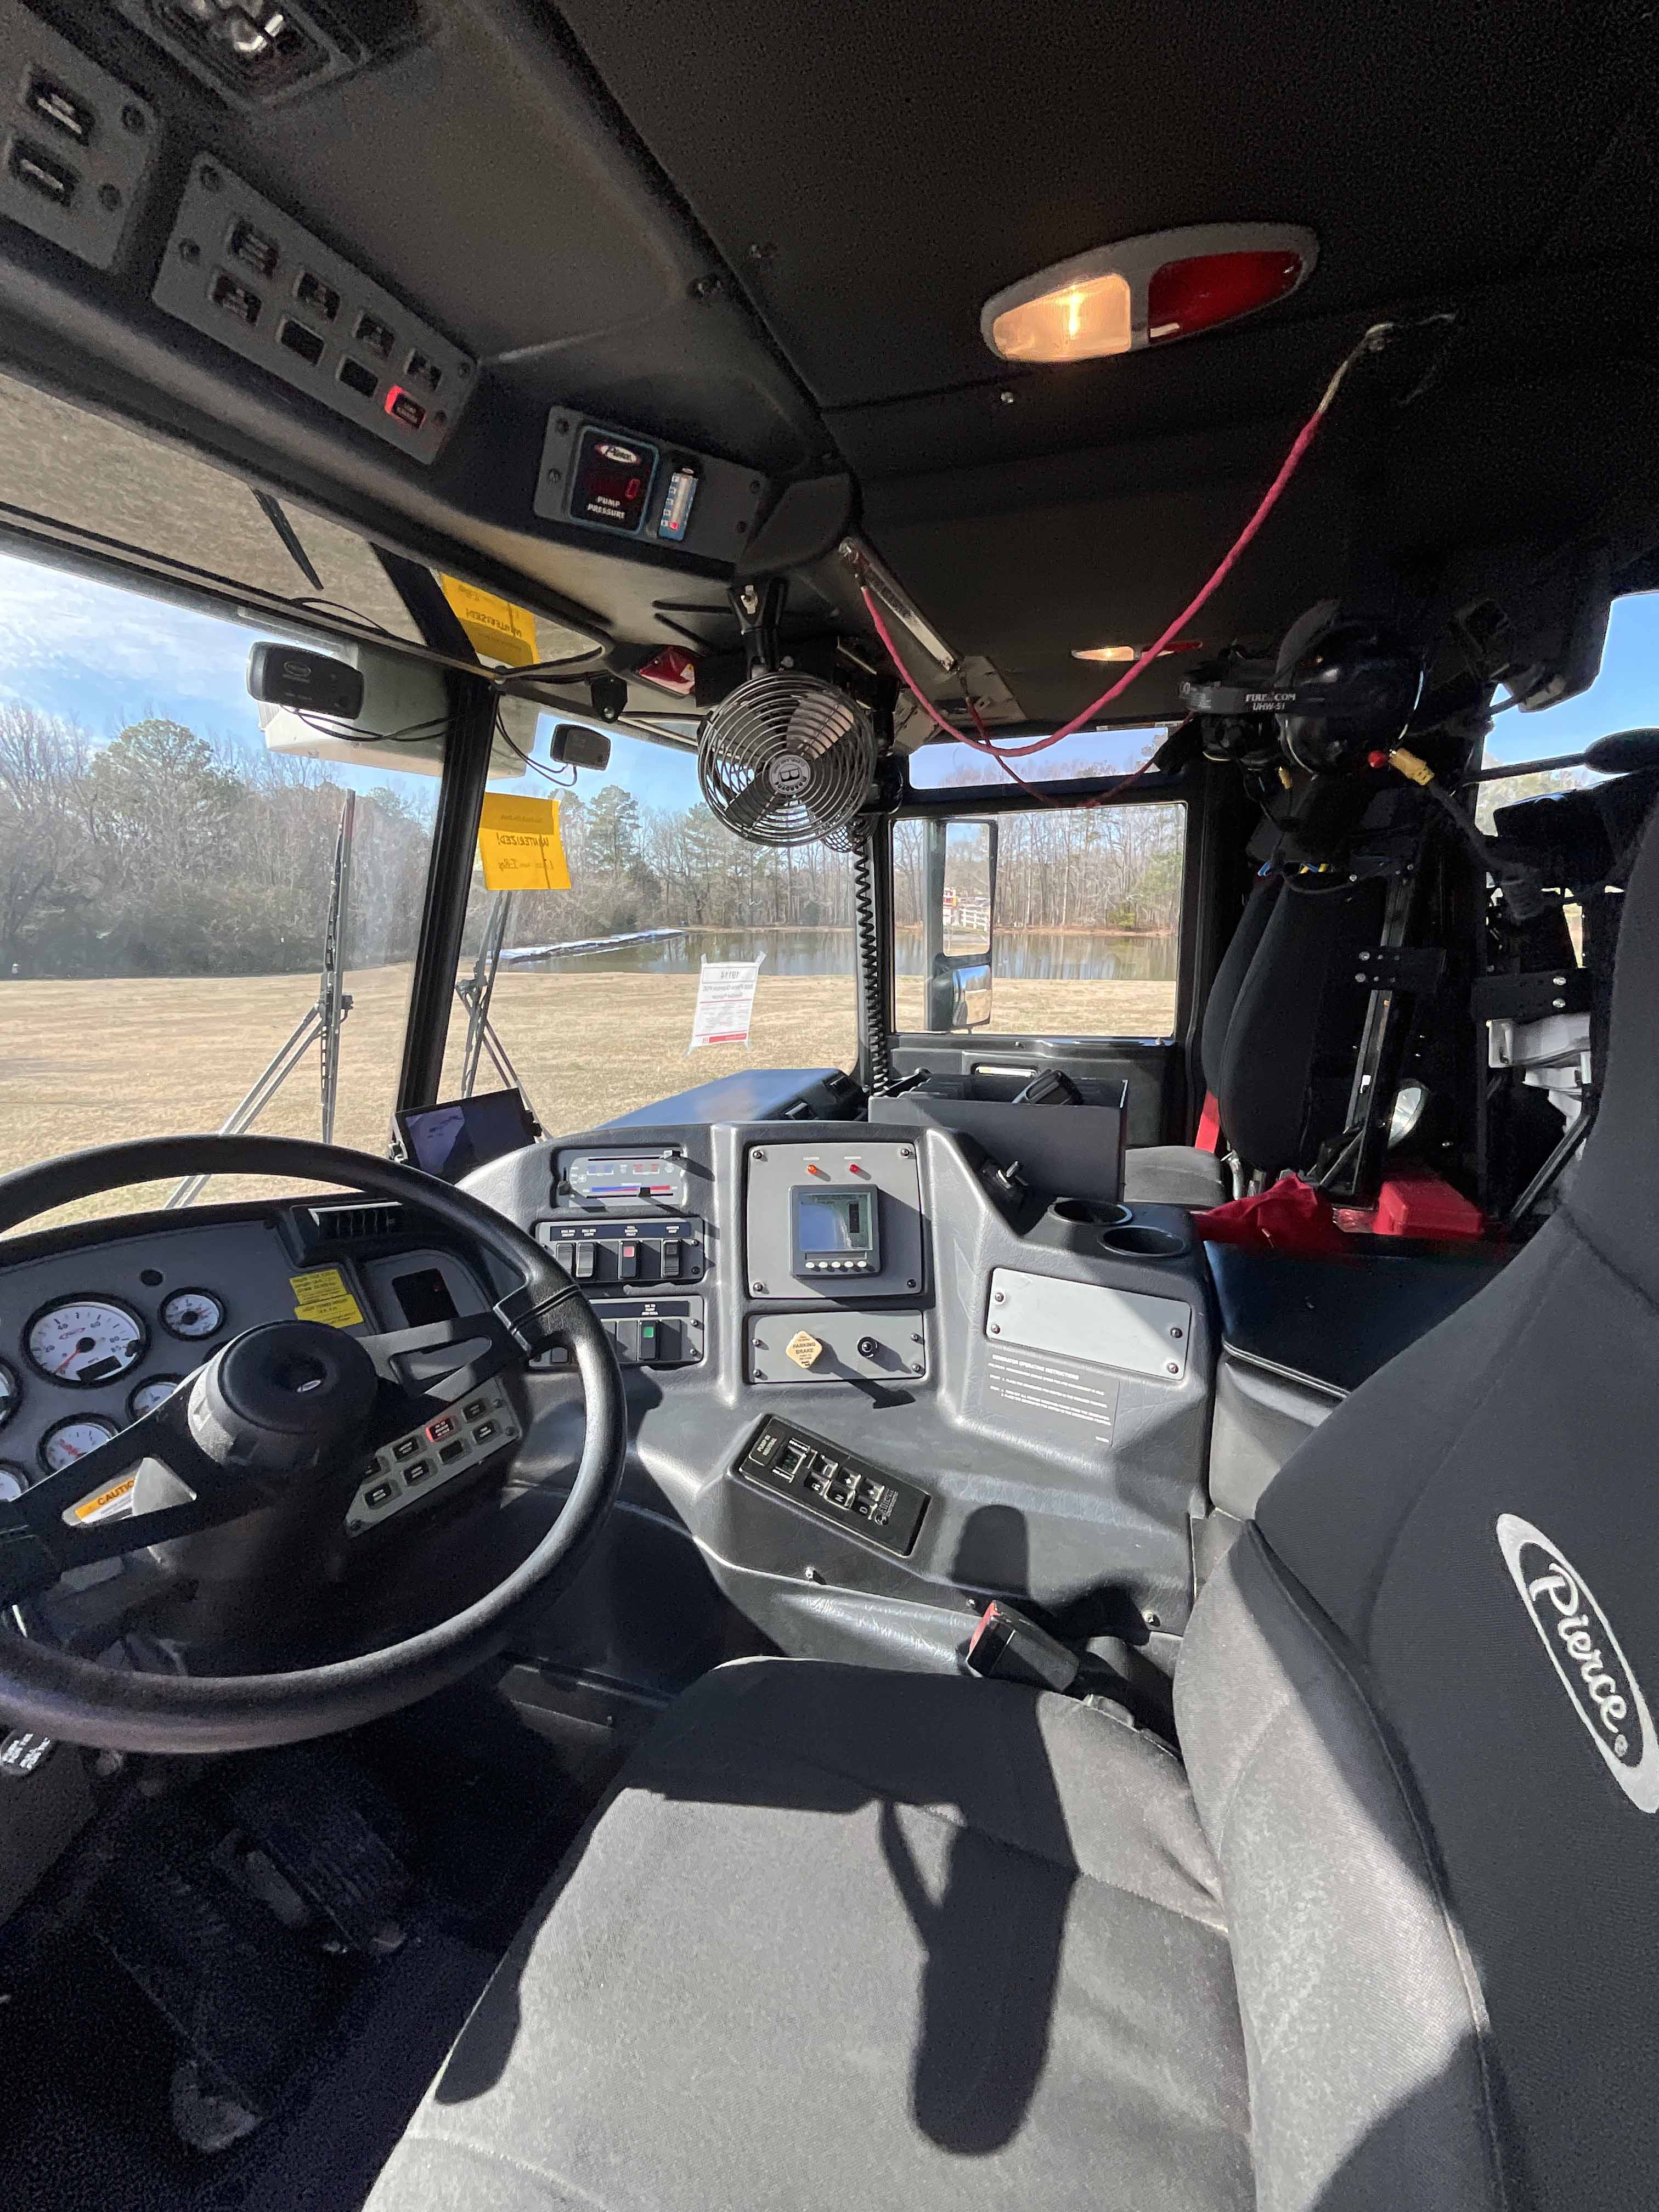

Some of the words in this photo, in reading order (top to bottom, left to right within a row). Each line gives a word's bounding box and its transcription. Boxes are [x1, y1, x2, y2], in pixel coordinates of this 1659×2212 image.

[597, 495, 620, 508] PUMP
[587, 503, 626, 520] PRESSURE
[1246, 693, 1268, 702] FIRE
[1274, 693, 1296, 701] COM
[763, 1438, 777, 1455] NEUTRAL
[97, 1480, 134, 1506] CAUTIO
[835, 1494, 844, 1502] N
[1529, 1561, 1627, 1734] Pierce
